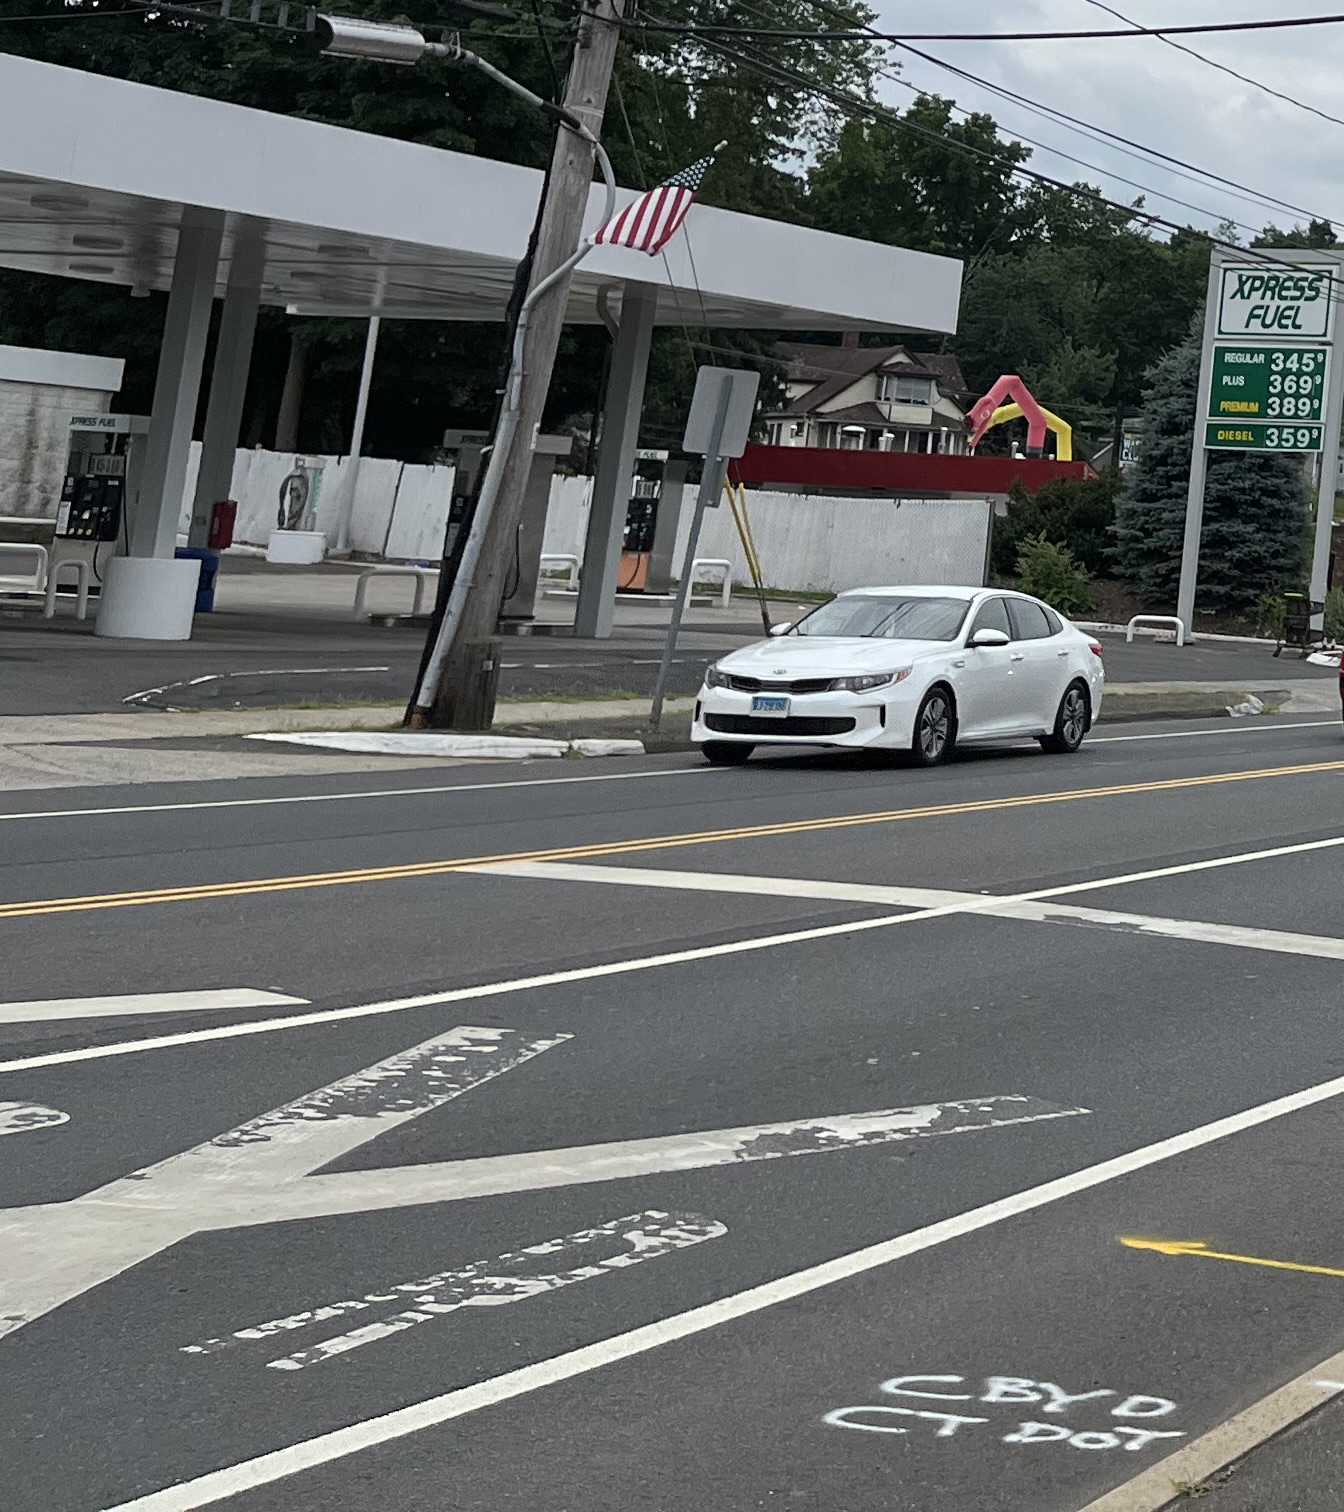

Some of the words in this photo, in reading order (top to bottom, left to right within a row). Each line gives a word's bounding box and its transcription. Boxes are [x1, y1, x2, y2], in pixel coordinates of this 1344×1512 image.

[1230, 273, 1326, 302] XPRESS
[1244, 304, 1303, 330] FUEL
[1224, 352, 1265, 364] REGULAR
[1222, 375, 1245, 386] PLUS
[1219, 401, 1259, 413] PREMIUM
[1217, 430, 1254, 441] DIESEL
[821, 1405, 989, 1437] CT
[1003, 1420, 1188, 1450] DOT
